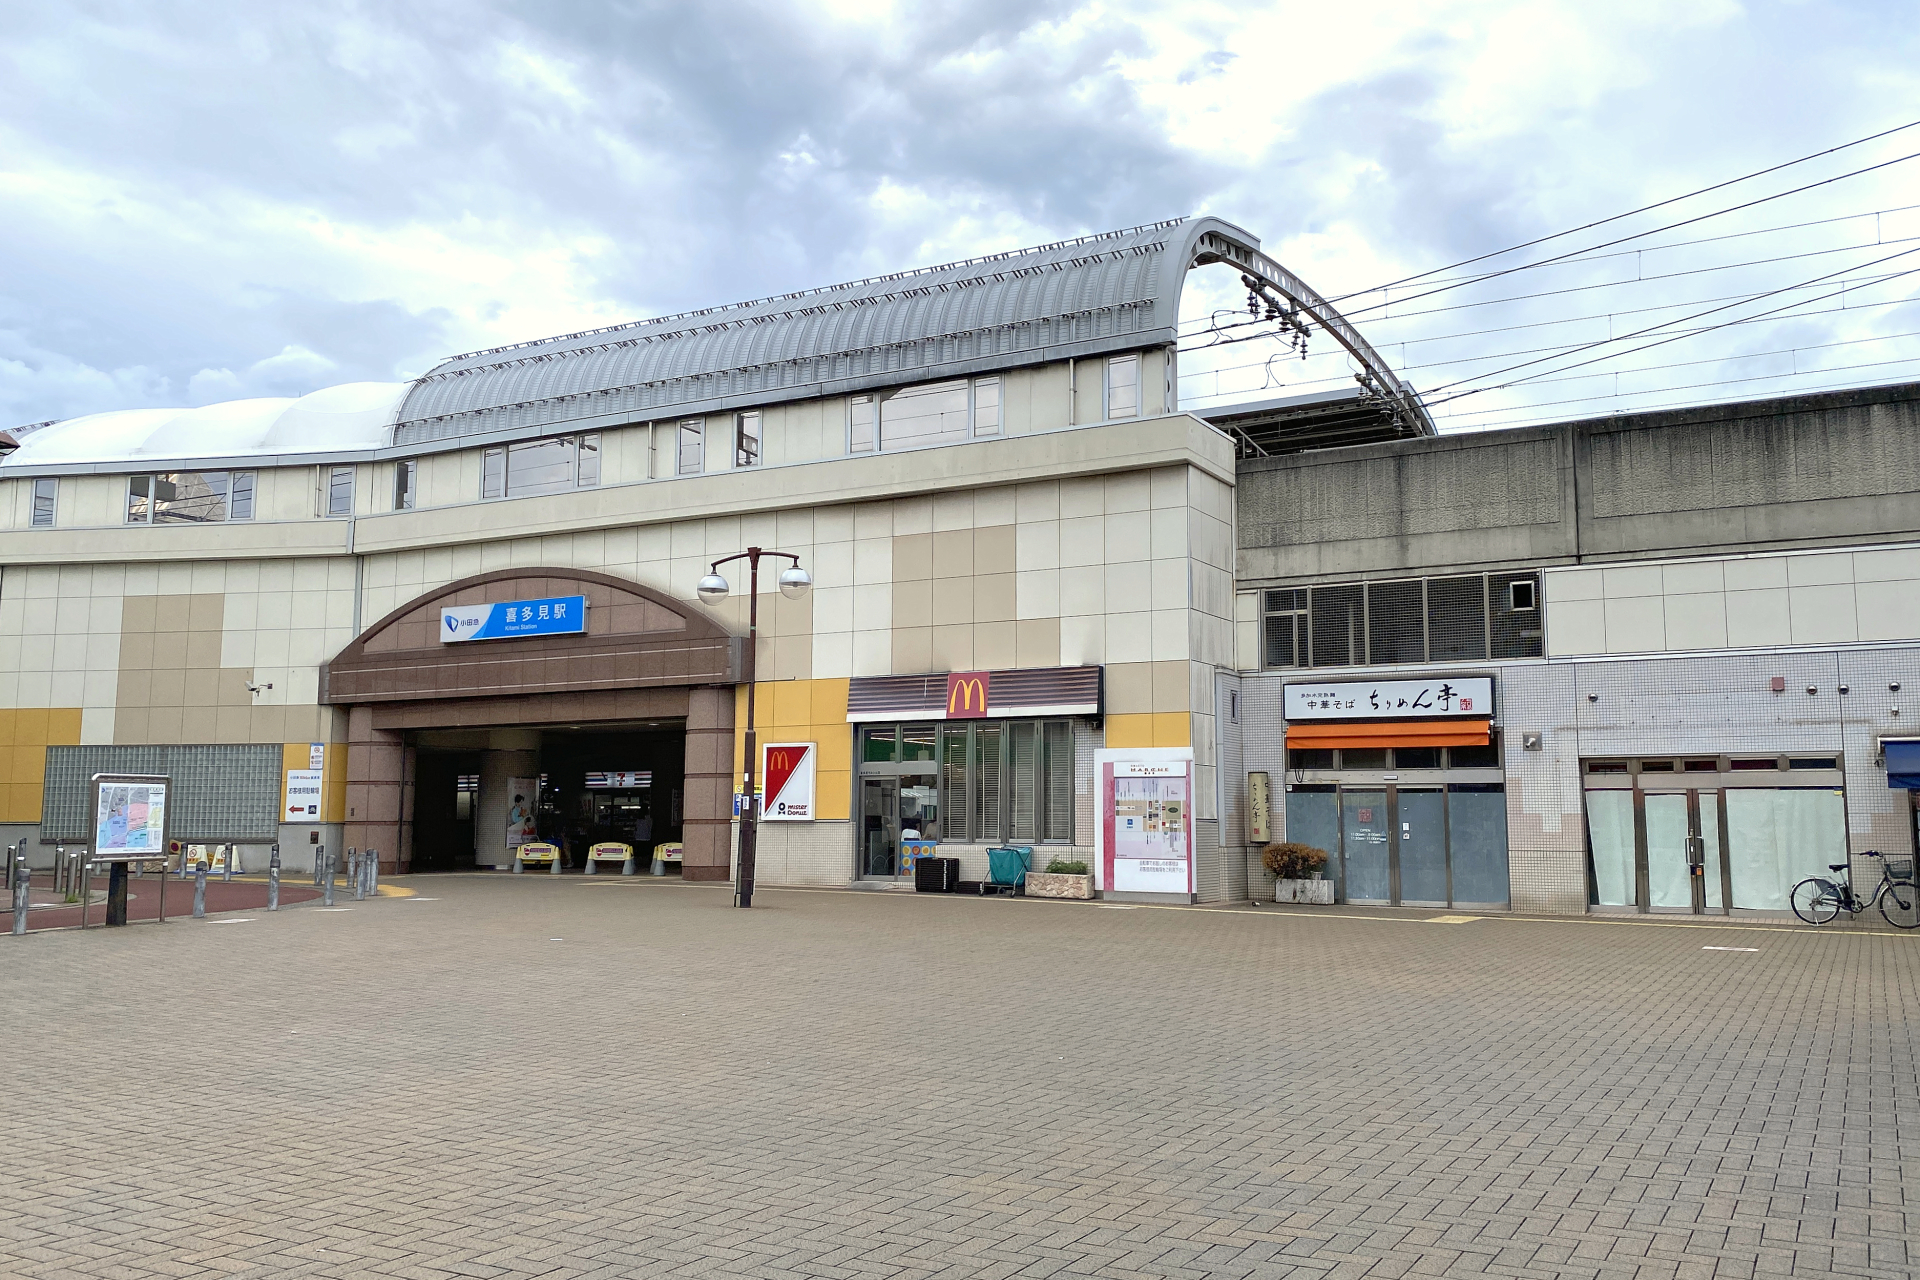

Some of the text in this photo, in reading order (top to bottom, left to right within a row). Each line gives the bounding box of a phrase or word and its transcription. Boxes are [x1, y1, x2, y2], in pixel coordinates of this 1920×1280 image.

[505, 603, 566, 623] 喜多見駅
[460, 618, 480, 627] 小田急
[1307, 699, 1356, 711] 中華そば
[1369, 683, 1458, 712] ちりめん亭
